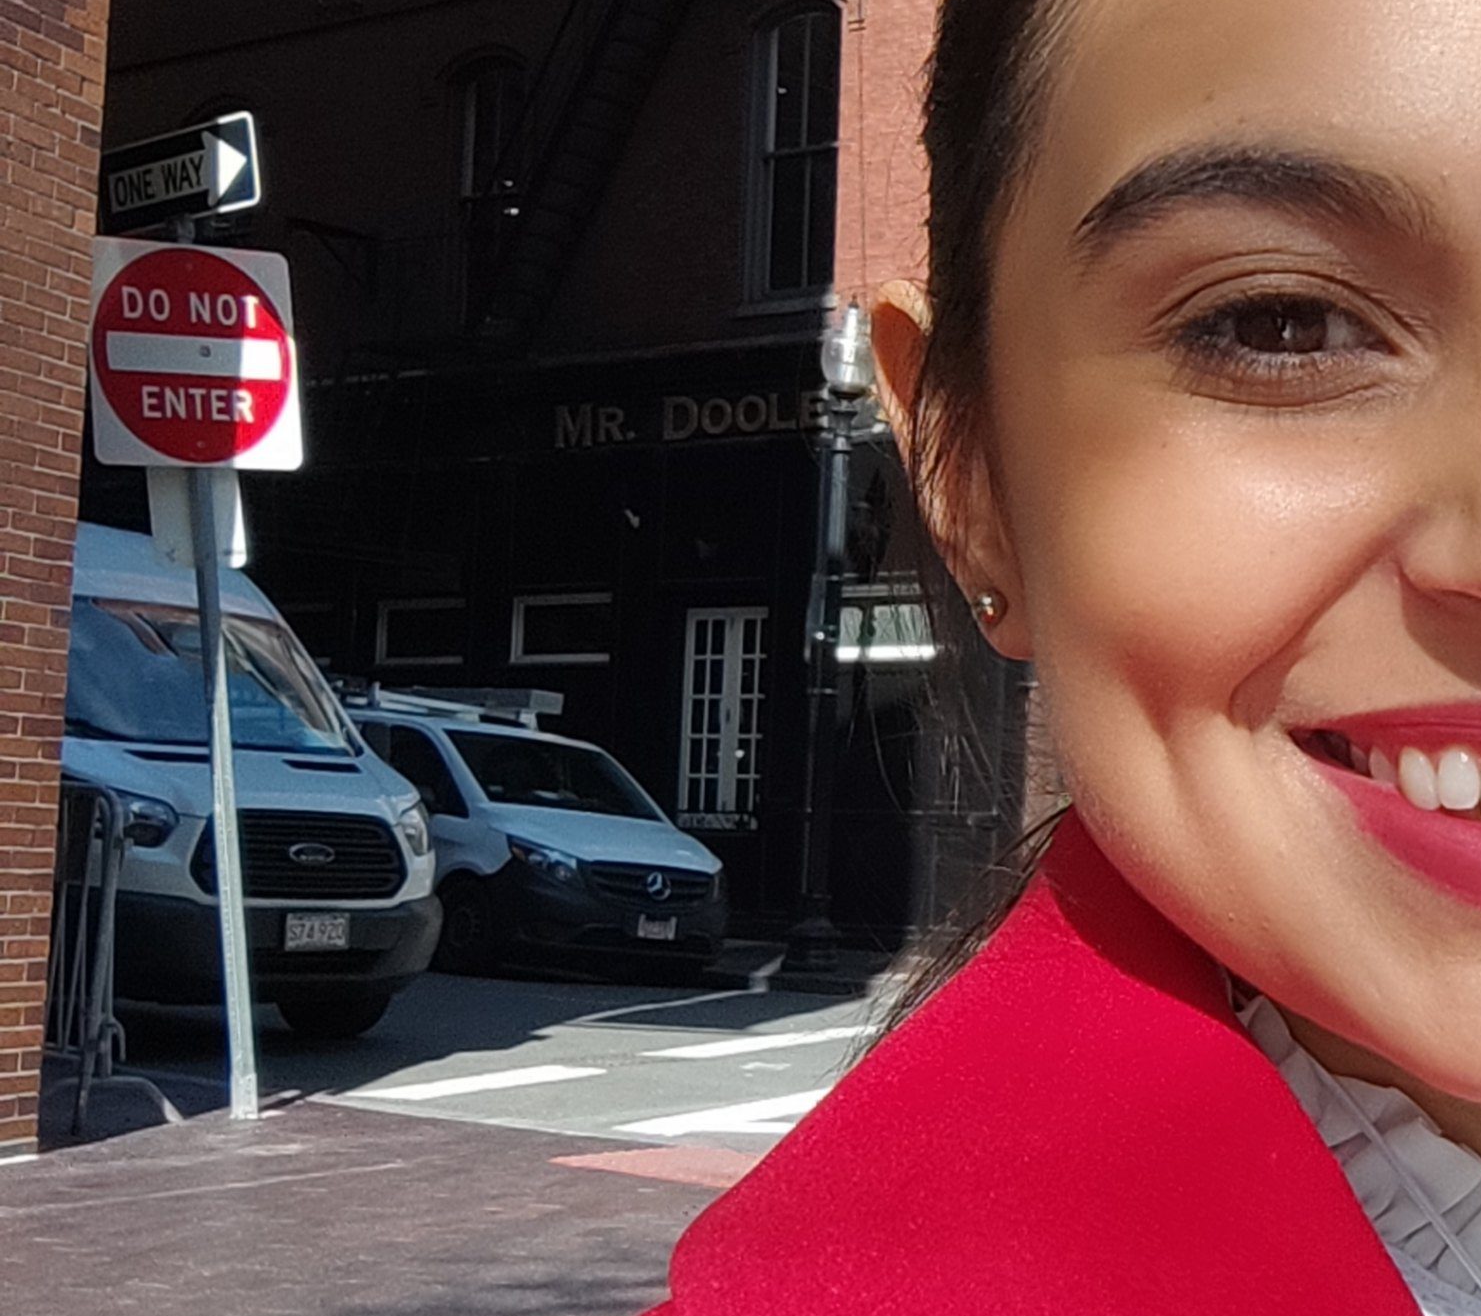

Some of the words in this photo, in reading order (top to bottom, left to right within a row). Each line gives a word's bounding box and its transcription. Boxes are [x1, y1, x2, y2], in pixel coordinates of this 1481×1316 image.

[113, 167, 155, 207] ONE
[160, 155, 204, 195] WAY
[121, 285, 171, 322] DO
[189, 291, 259, 330] NOT
[141, 384, 255, 424] ENTER
[553, 402, 636, 449] MR.
